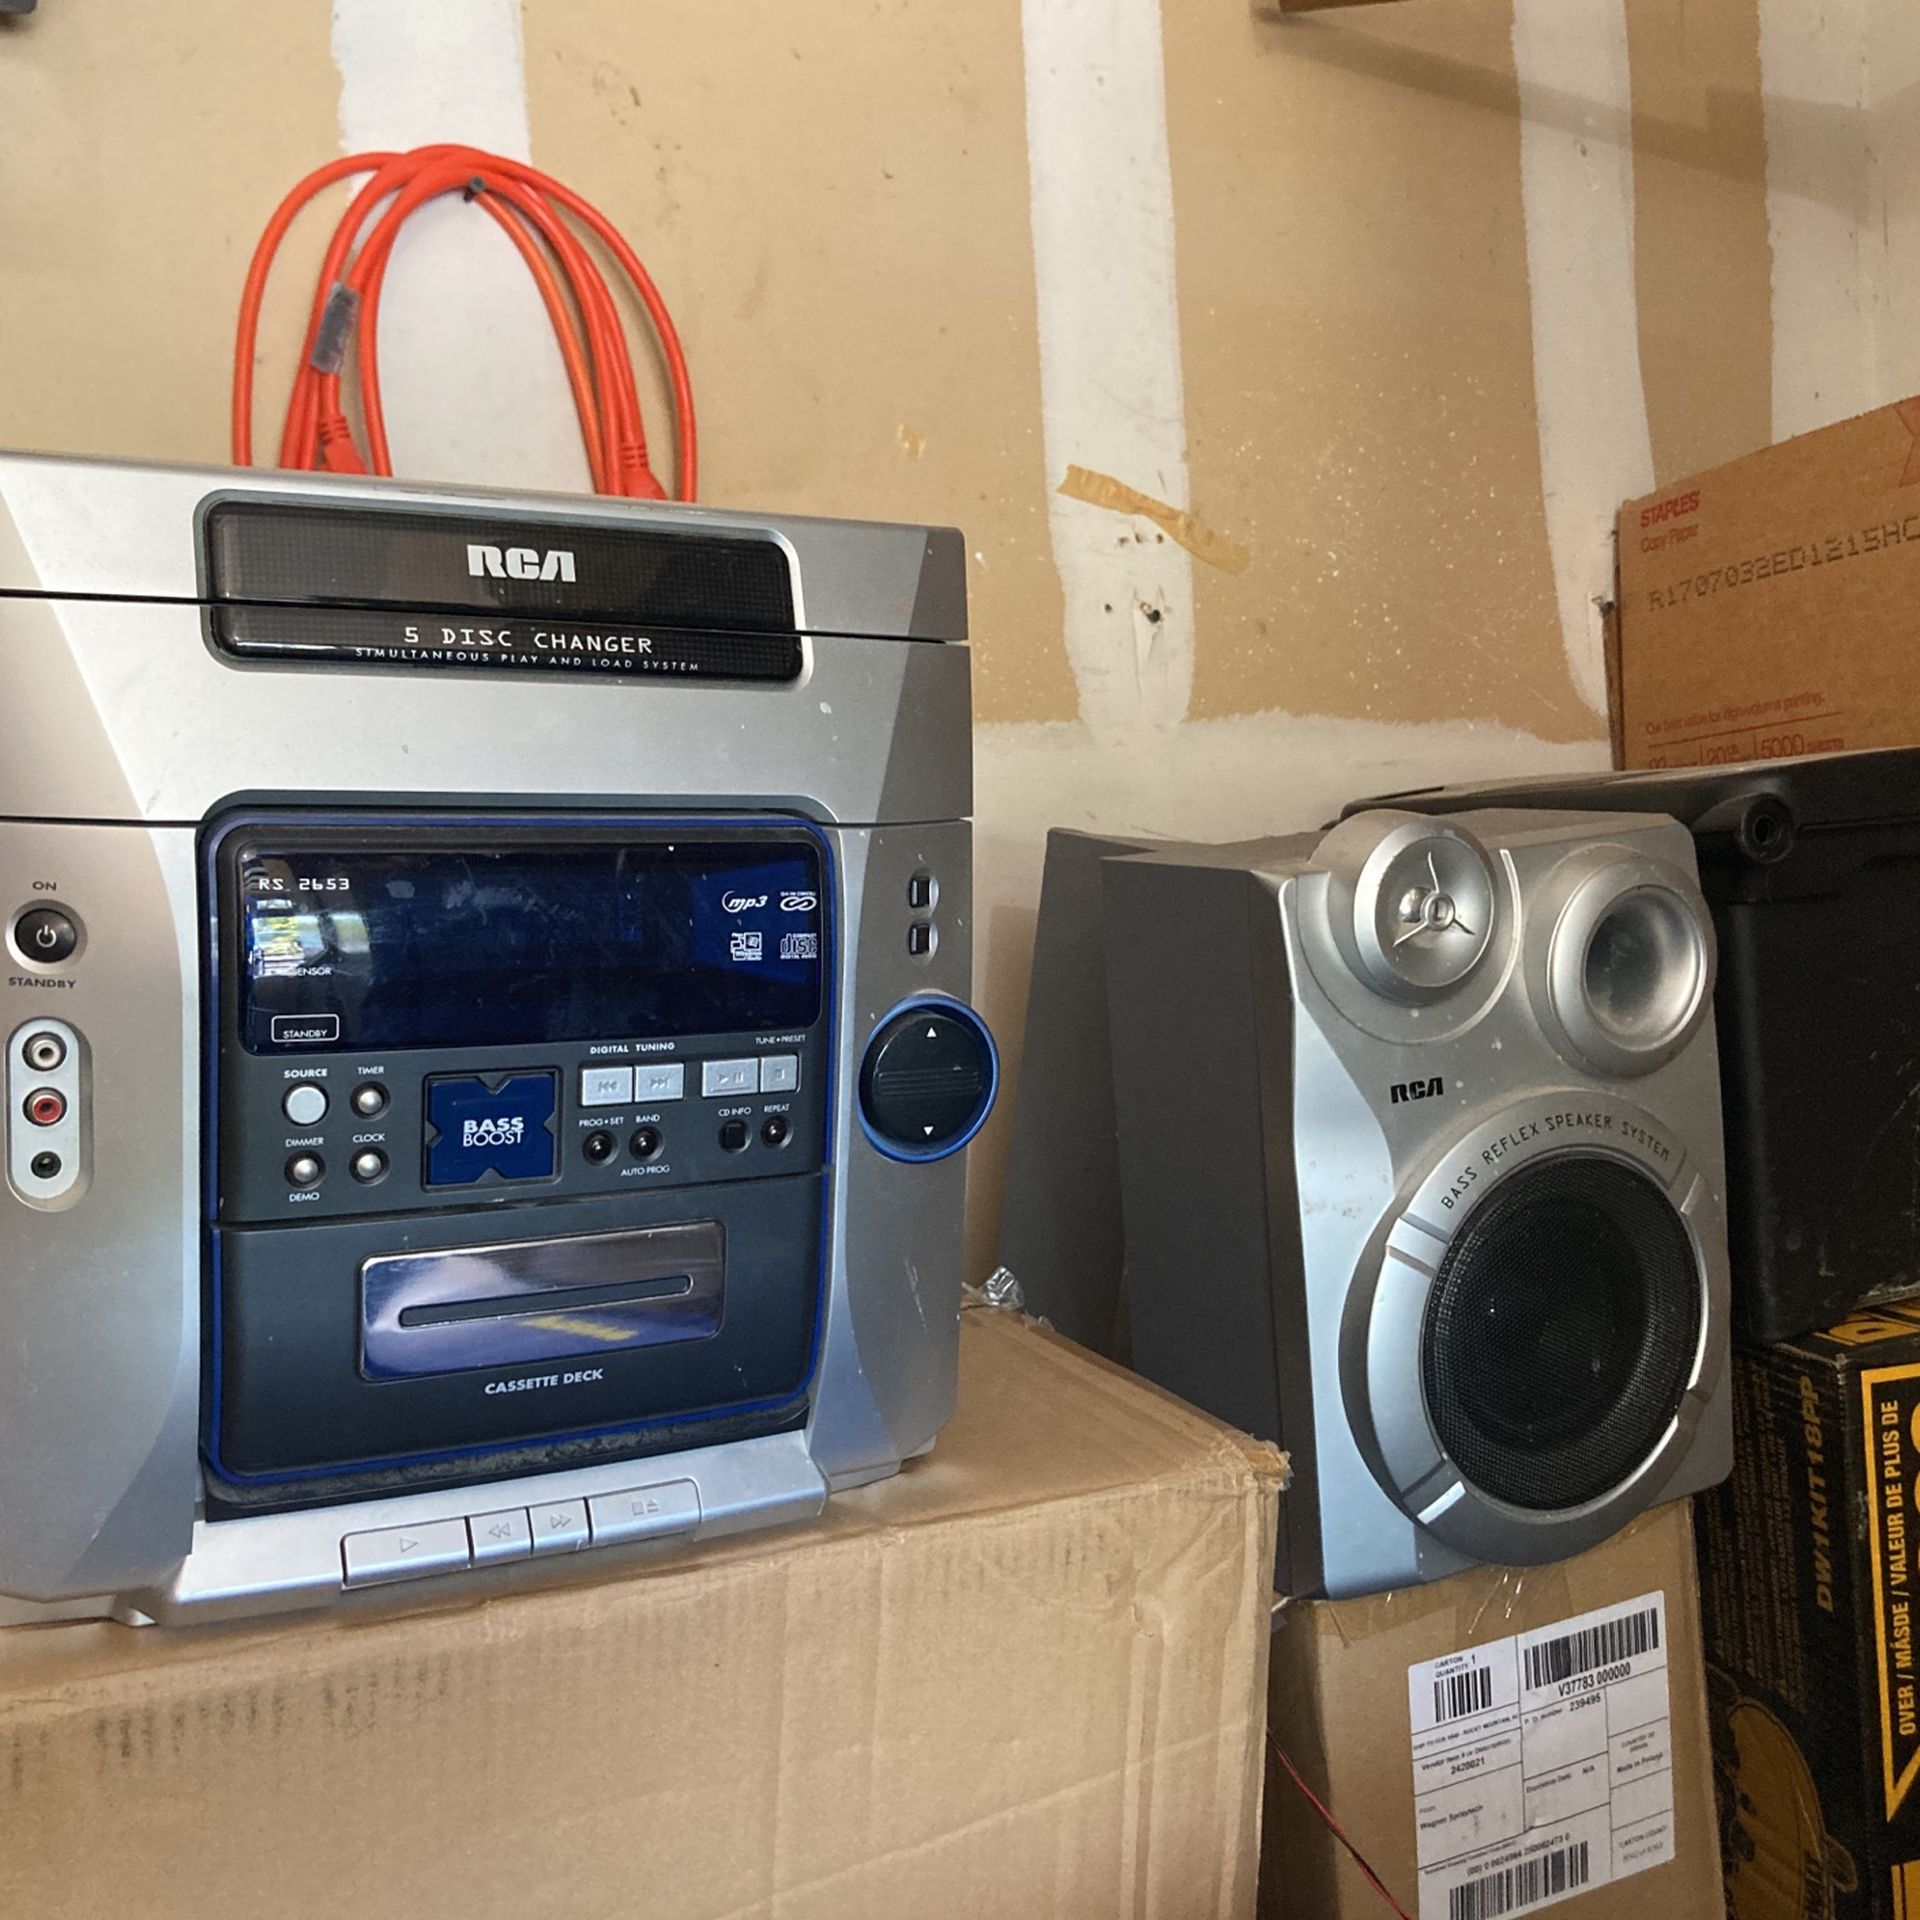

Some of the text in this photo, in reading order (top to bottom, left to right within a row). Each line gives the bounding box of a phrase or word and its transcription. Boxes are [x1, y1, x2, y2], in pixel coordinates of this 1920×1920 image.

[1640, 489, 1700, 528] STAPLES
[467, 544, 577, 583] RCA
[404, 627, 653, 654] 5 DISC CHANGER
[355, 648, 699, 672] SIMULTANEOUS PLAY AND LOAD SYSTEM
[1760, 734, 1805, 759] 5000
[32, 881, 57, 891] ON
[258, 878, 350, 891] RS 2653
[724, 893, 768, 911] mp3
[8, 977, 77, 990] STANDBY
[283, 1029, 328, 1039] STANDBY
[590, 1042, 675, 1055] DIGITAL TUNING
[284, 1068, 328, 1079] SOURCE
[357, 1066, 385, 1075] TIMER
[1390, 1076, 1444, 1104] RCA
[718, 1106, 752, 1117] CD INFO
[764, 1103, 790, 1113] REPEAT
[463, 1117, 524, 1133] BASS
[636, 1113, 660, 1123] BAND
[285, 1137, 324, 1147] DIMMER
[352, 1133, 385, 1143] CLOCK
[463, 1130, 523, 1147] BOOST
[1441, 1112, 1670, 1210] BASS REFLEX SPEAKER SYSTEM
[620, 1165, 670, 1177] AUTO PROG
[289, 1192, 320, 1203] DEMO
[484, 1368, 604, 1395] CASSETTE DECK
[1881, 1400, 1898, 1425] DE
[1882, 1430, 1901, 1478] PLUS
[1799, 1375, 1834, 1612] DW1KIT18PP
[1885, 1483, 1903, 1508] DE
[1887, 1512, 1908, 1586] VALEUR
[1435, 1656, 1463, 1669] CARTON
[1435, 1663, 1469, 1678] QUANTITY
[1558, 1662, 1631, 1696] V37783 000000
[1569, 1692, 1601, 1712] 239495
[1897, 1685, 1917, 1736] OVER
